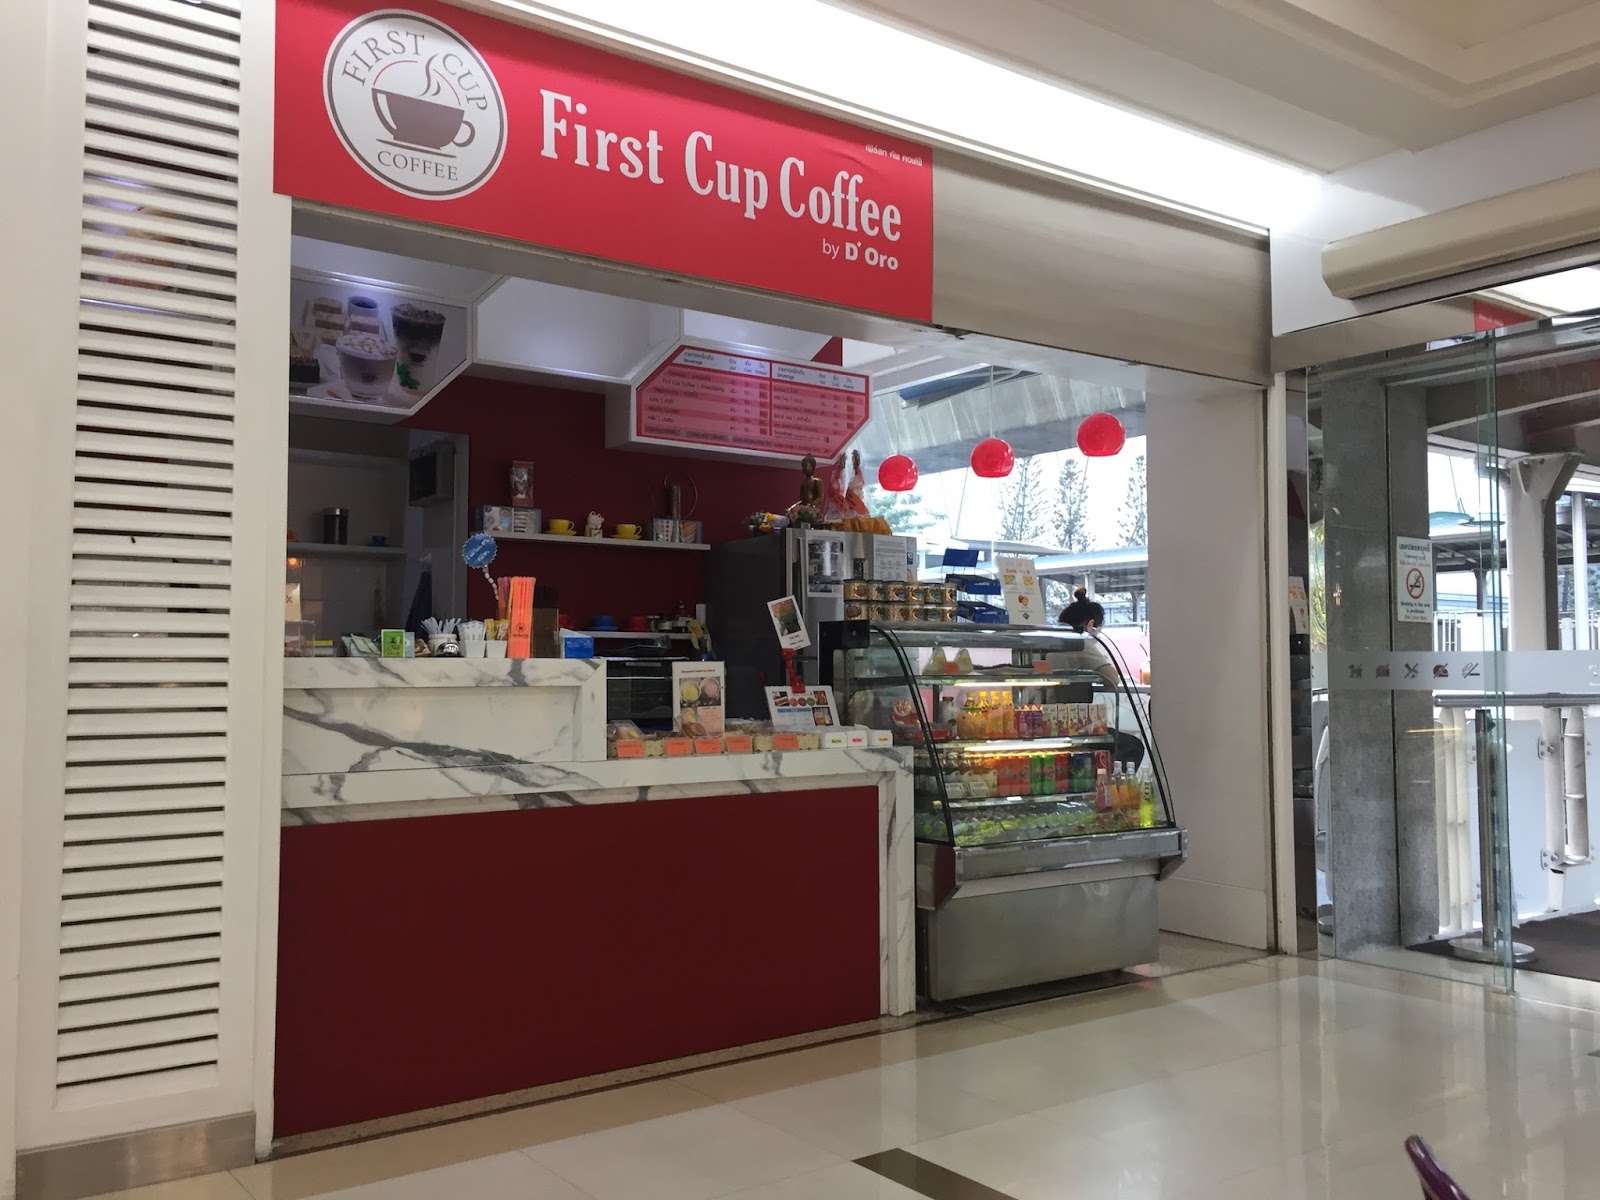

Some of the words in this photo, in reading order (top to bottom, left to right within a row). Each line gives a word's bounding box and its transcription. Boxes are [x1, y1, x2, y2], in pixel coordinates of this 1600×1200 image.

[342, 30, 425, 87] FIRST
[442, 53, 488, 111] CUP
[377, 150, 458, 182] COFFEE
[539, 88, 665, 185] First
[684, 130, 769, 220] Cup
[779, 156, 901, 242] Coffee
[822, 238, 840, 260] by
